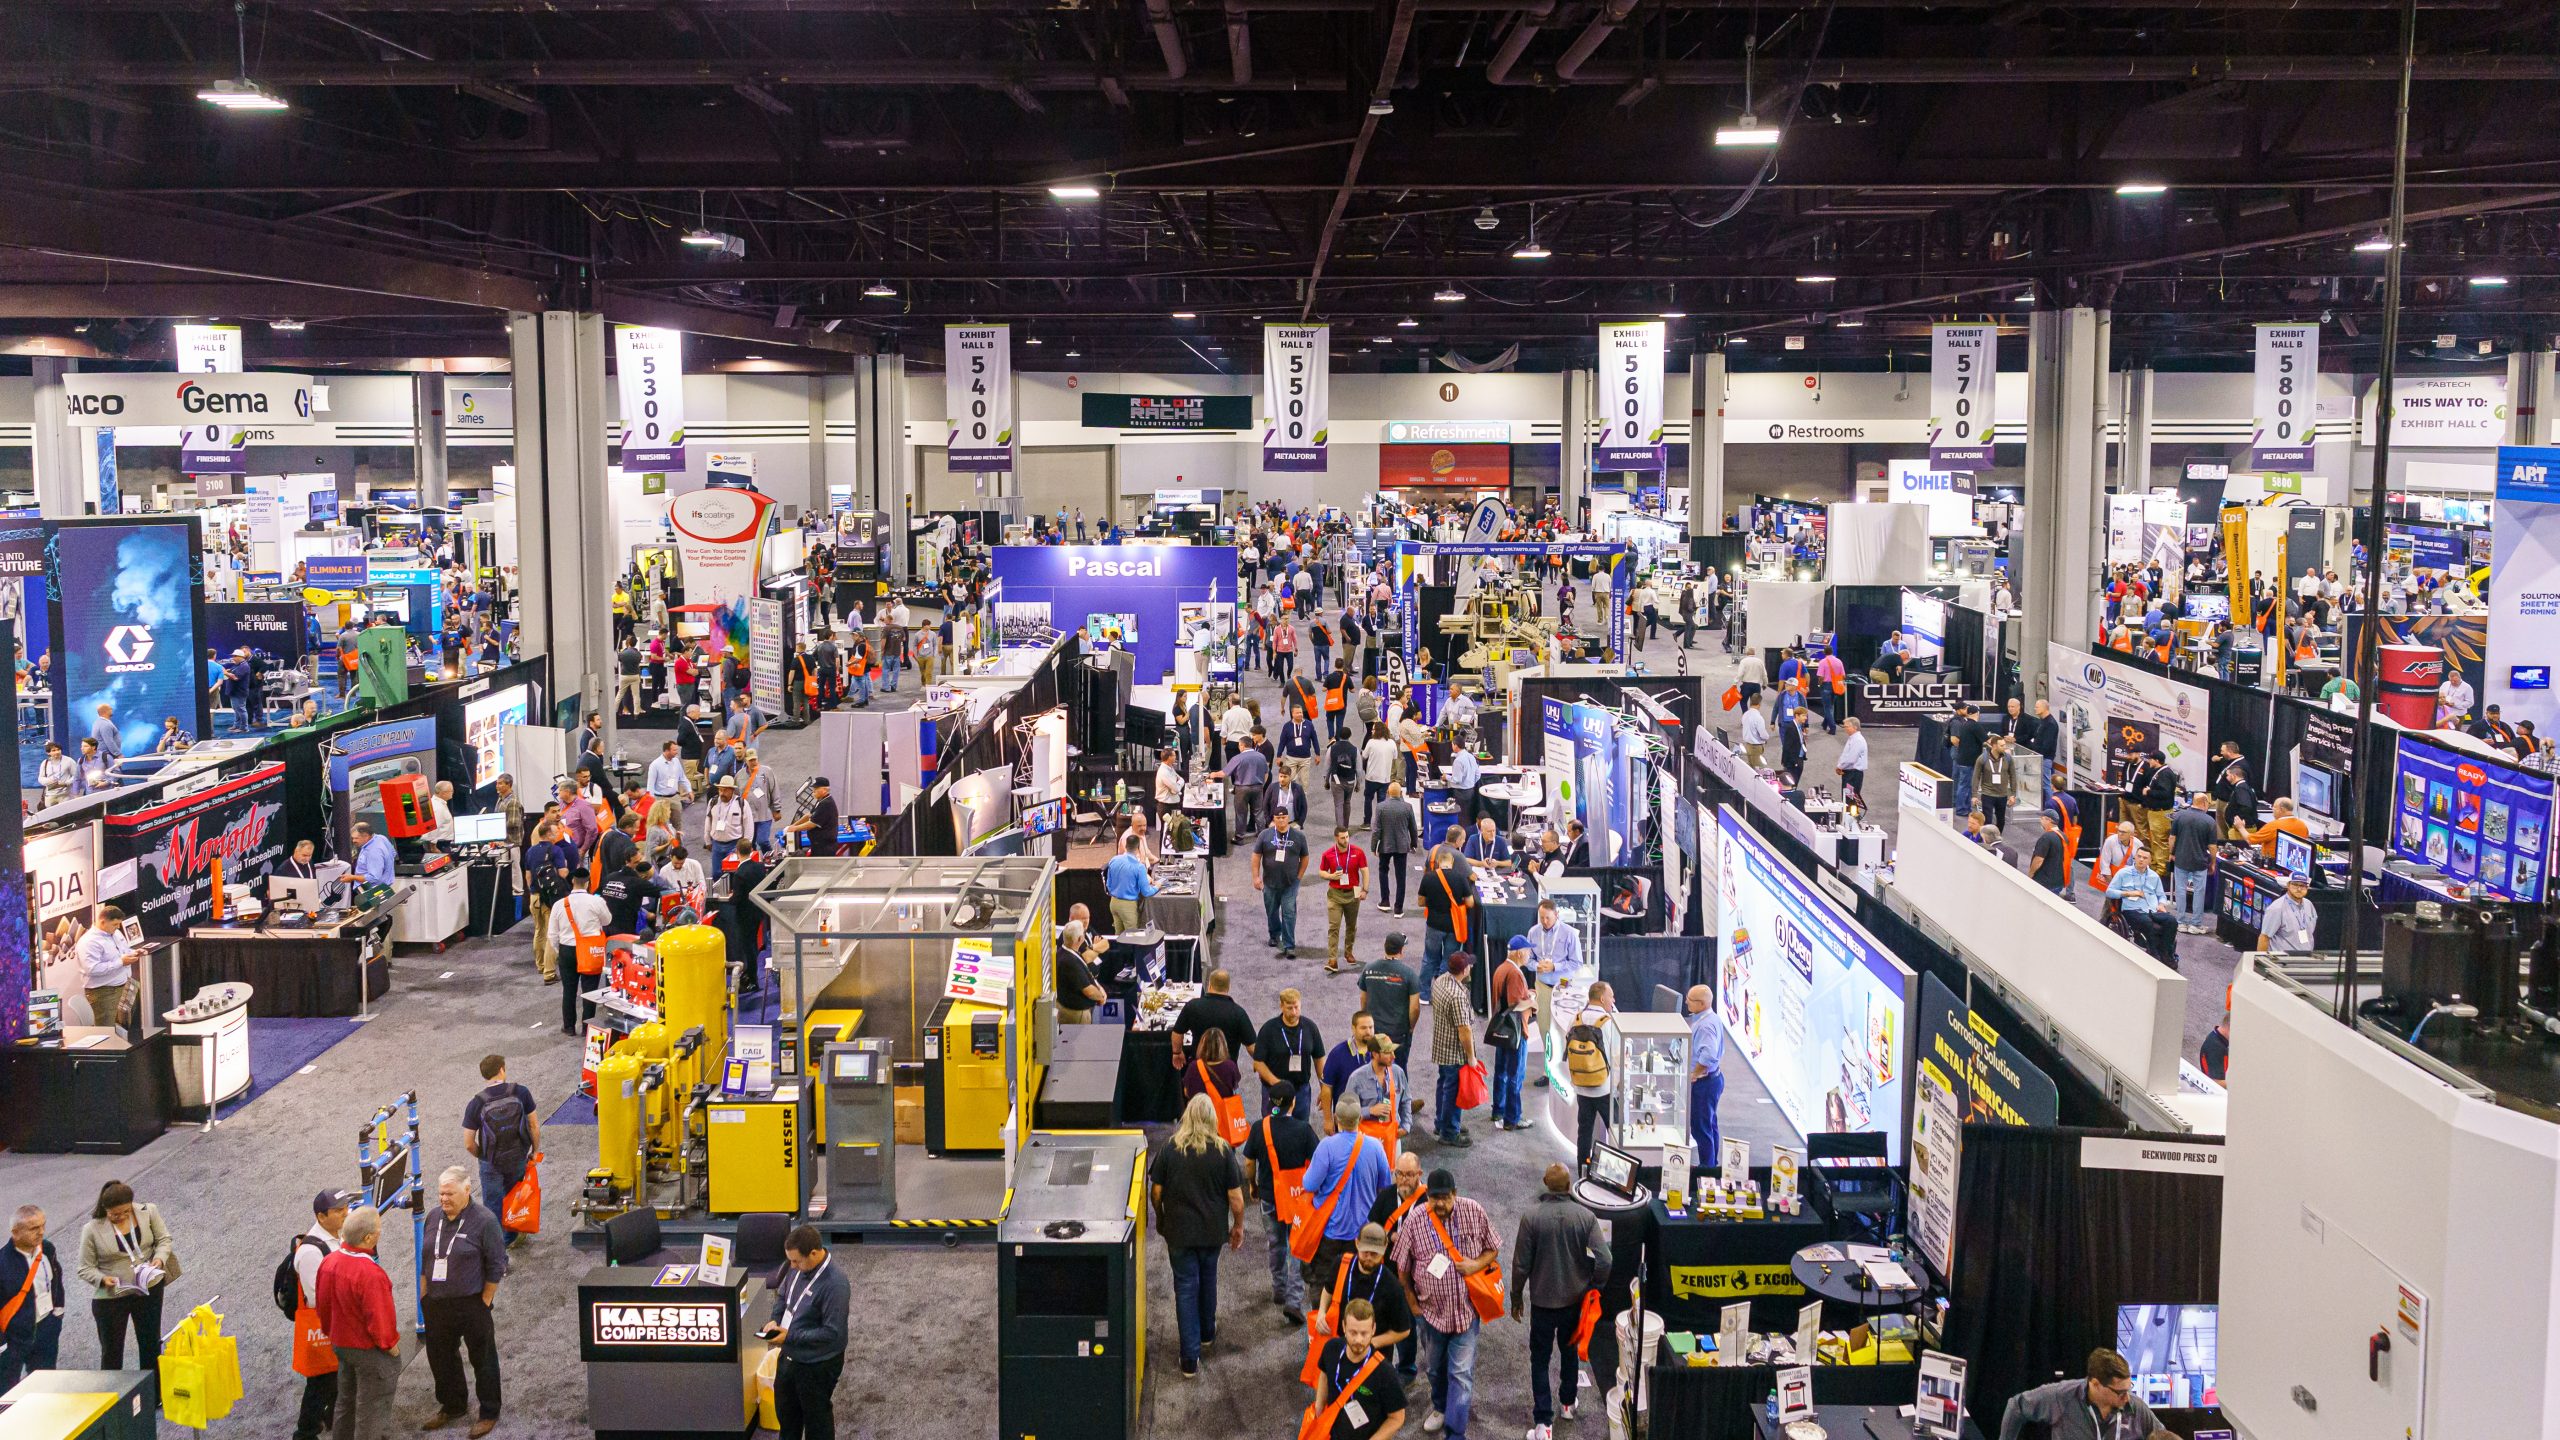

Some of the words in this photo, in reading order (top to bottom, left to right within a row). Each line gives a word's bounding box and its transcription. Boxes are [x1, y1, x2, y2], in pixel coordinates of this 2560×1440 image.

[959, 331, 996, 339] EXHIBIT
[2269, 330, 2306, 338] EXHIBIT
[193, 344, 216, 352] HALL
[961, 341, 985, 349] HALL
[987, 341, 994, 349] B
[1280, 341, 1304, 349] HALL
[1306, 341, 1313, 349] B
[1615, 340, 1639, 348] HALL
[1642, 340, 1648, 348] B
[1948, 340, 1972, 348] HALL
[1975, 340, 1981, 348] B
[2271, 340, 2294, 348] HALL
[2297, 340, 2303, 348] B
[182, 384, 268, 414] Gema
[643, 356, 660, 440] 5300
[971, 356, 987, 440] 5400
[1289, 355, 1303, 440] 5500
[1624, 355, 1639, 439] 5600
[1956, 354, 1971, 439] 5700
[2277, 355, 2293, 439] 5800
[2403, 398, 2431, 408] THIS
[2435, 398, 2462, 408] WAY
[2467, 398, 2488, 408] TO:
[68, 394, 125, 415] ACO
[456, 413, 484, 425] sames
[2401, 420, 2443, 428] EXHIBIT
[2448, 420, 2477, 428] HALL
[2480, 420, 2488, 428] C
[1410, 425, 1508, 440] Refreshments
[1788, 423, 1865, 439] Restrooms
[196, 455, 231, 463] FINISHING
[636, 453, 671, 461] FINISHING
[2511, 463, 2548, 482] ART
[205, 479, 224, 490] 5100
[2271, 476, 2292, 488] 5800
[691, 510, 703, 519] ifs
[703, 511, 735, 521] coatings
[2223, 513, 2243, 523] COE
[5, 552, 25, 561] INTO
[309, 566, 353, 574] ELIMINATE
[1068, 556, 1162, 577] Pascal
[235, 622, 251, 631] THE
[253, 622, 288, 631] FUTURE
[1404, 600, 1412, 653] AUTOMATION
[1614, 597, 1622, 650] AUTOMATION
[105, 662, 155, 673] GRACO
[1863, 684, 1962, 699] CLINCH
[1884, 700, 1943, 708] SOLUTIONS
[2331, 721, 2354, 734] Press
[370, 728, 417, 749] COMPANY
[2457, 767, 2486, 782] READY
[162, 803, 266, 888] Monode
[141, 888, 182, 914] Solutions
[182, 883, 195, 895] for
[228, 860, 243, 875] and
[243, 844, 284, 868] Traceability
[1788, 927, 1813, 967] Oberg
[742, 1048, 762, 1056] CAGI
[1934, 1032, 1966, 1080] METAL
[1947, 1009, 1984, 1056] Corrosion
[1983, 1043, 2021, 1090] Solutions
[1975, 1054, 1988, 1077] for
[783, 1108, 793, 1168] KAESER
[2141, 1150, 2180, 1162] BECKWOOD
[2182, 1151, 2206, 1163] PRESS
[1679, 1272, 1728, 1289] ZERUST
[600, 1307, 720, 1327] KAESER
[600, 1327, 721, 1342] COMPRESSORS
